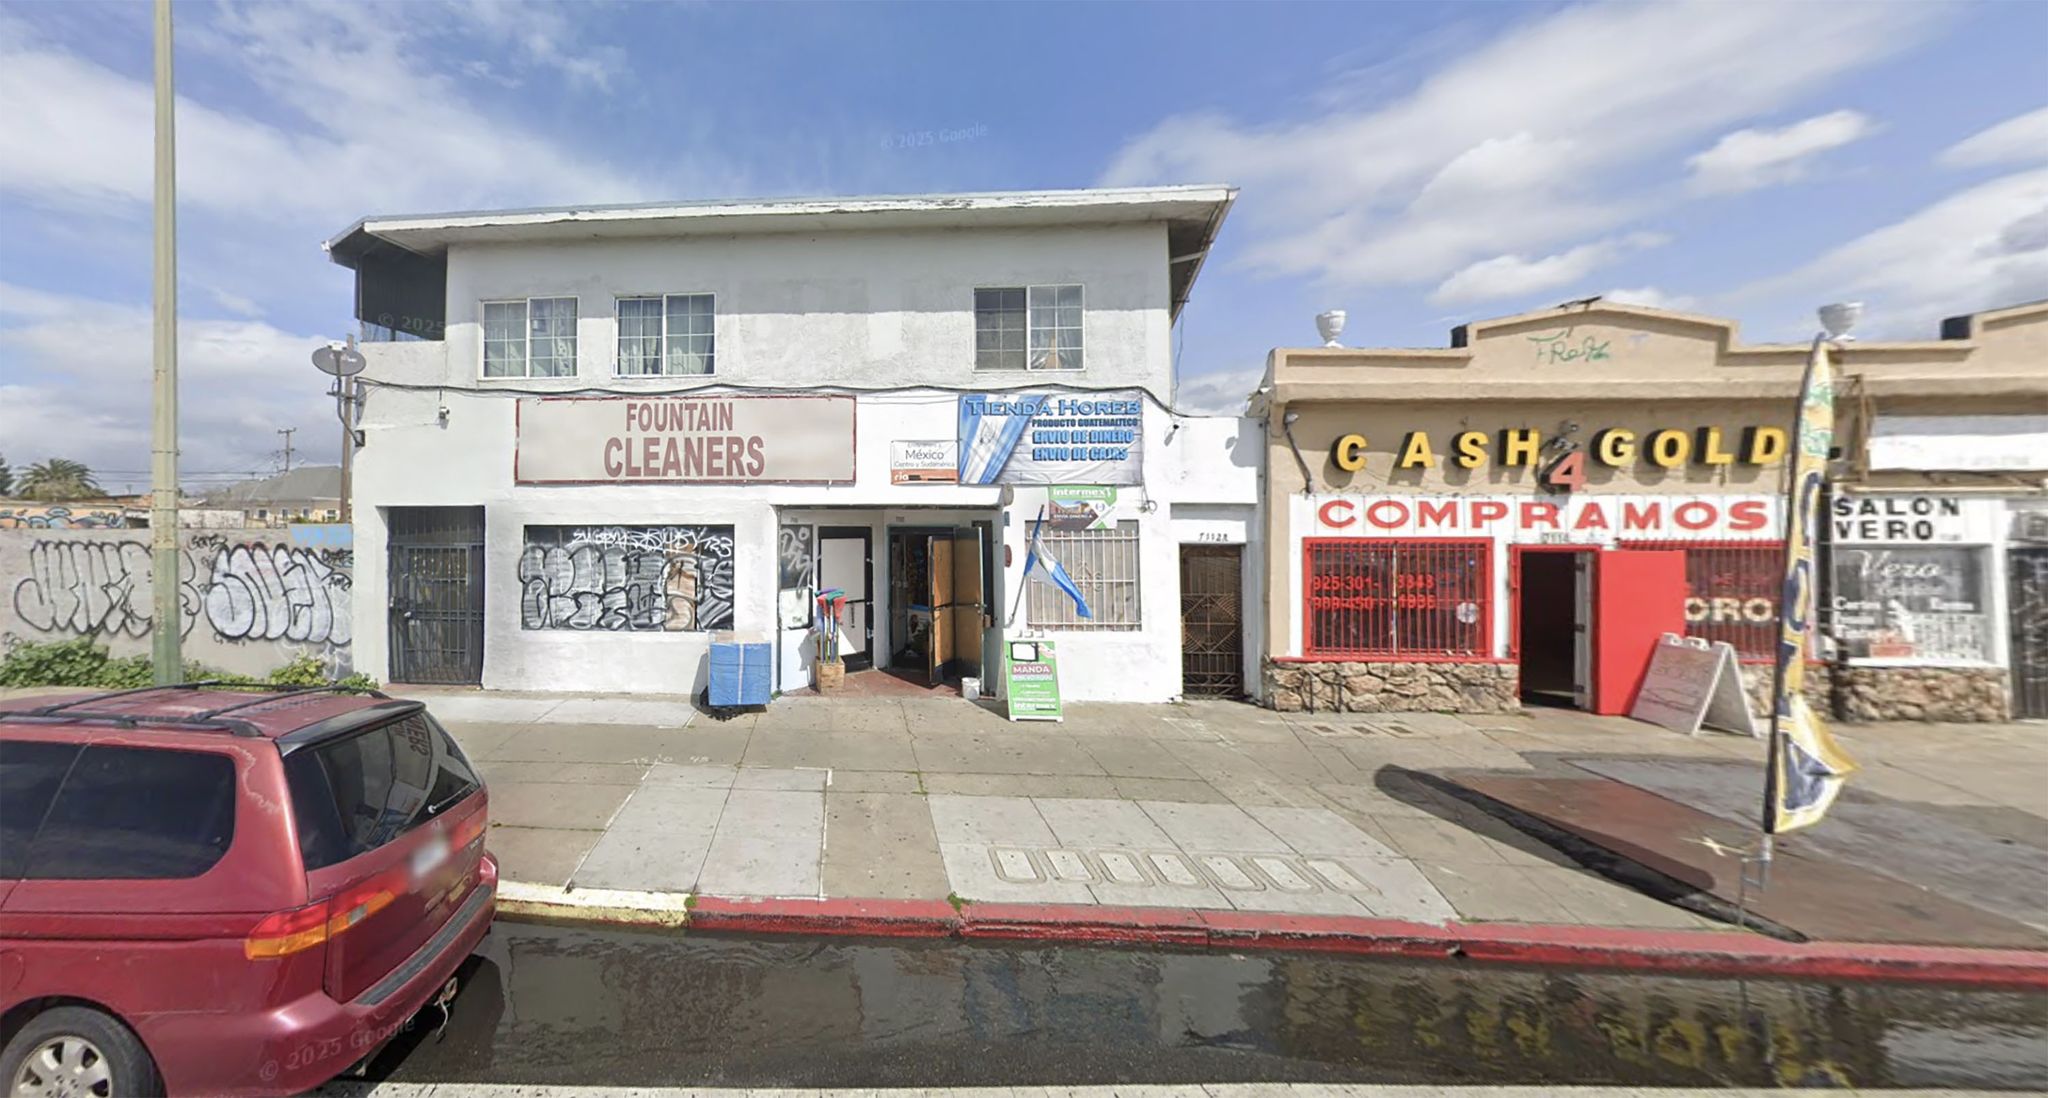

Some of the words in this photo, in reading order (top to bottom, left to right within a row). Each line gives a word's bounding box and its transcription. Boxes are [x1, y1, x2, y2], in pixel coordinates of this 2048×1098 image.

[626, 402, 733, 432] FOUNTAIN
[1032, 418, 1076, 428] PRODUCTO
[1078, 418, 1138, 428] GUATEMALTECO
[1032, 430, 1070, 444] ENVIO
[1072, 430, 1087, 444] DE
[1089, 430, 1134, 444] DINERO
[604, 435, 765, 478] CLEANERS
[905, 449, 944, 460] México
[1032, 447, 1070, 462] ENVIO
[1072, 447, 1087, 462] DE
[1089, 447, 1129, 462] CAJAS
[1334, 428, 1541, 474] CASH
[1546, 449, 1587, 492] 4
[1592, 424, 1789, 470] GOLD
[1317, 499, 1770, 531] COMPRAMOS
[1834, 497, 1961, 517] SALON
[1834, 520, 1935, 541] VERO
[1848, 549, 1941, 577] Vero
